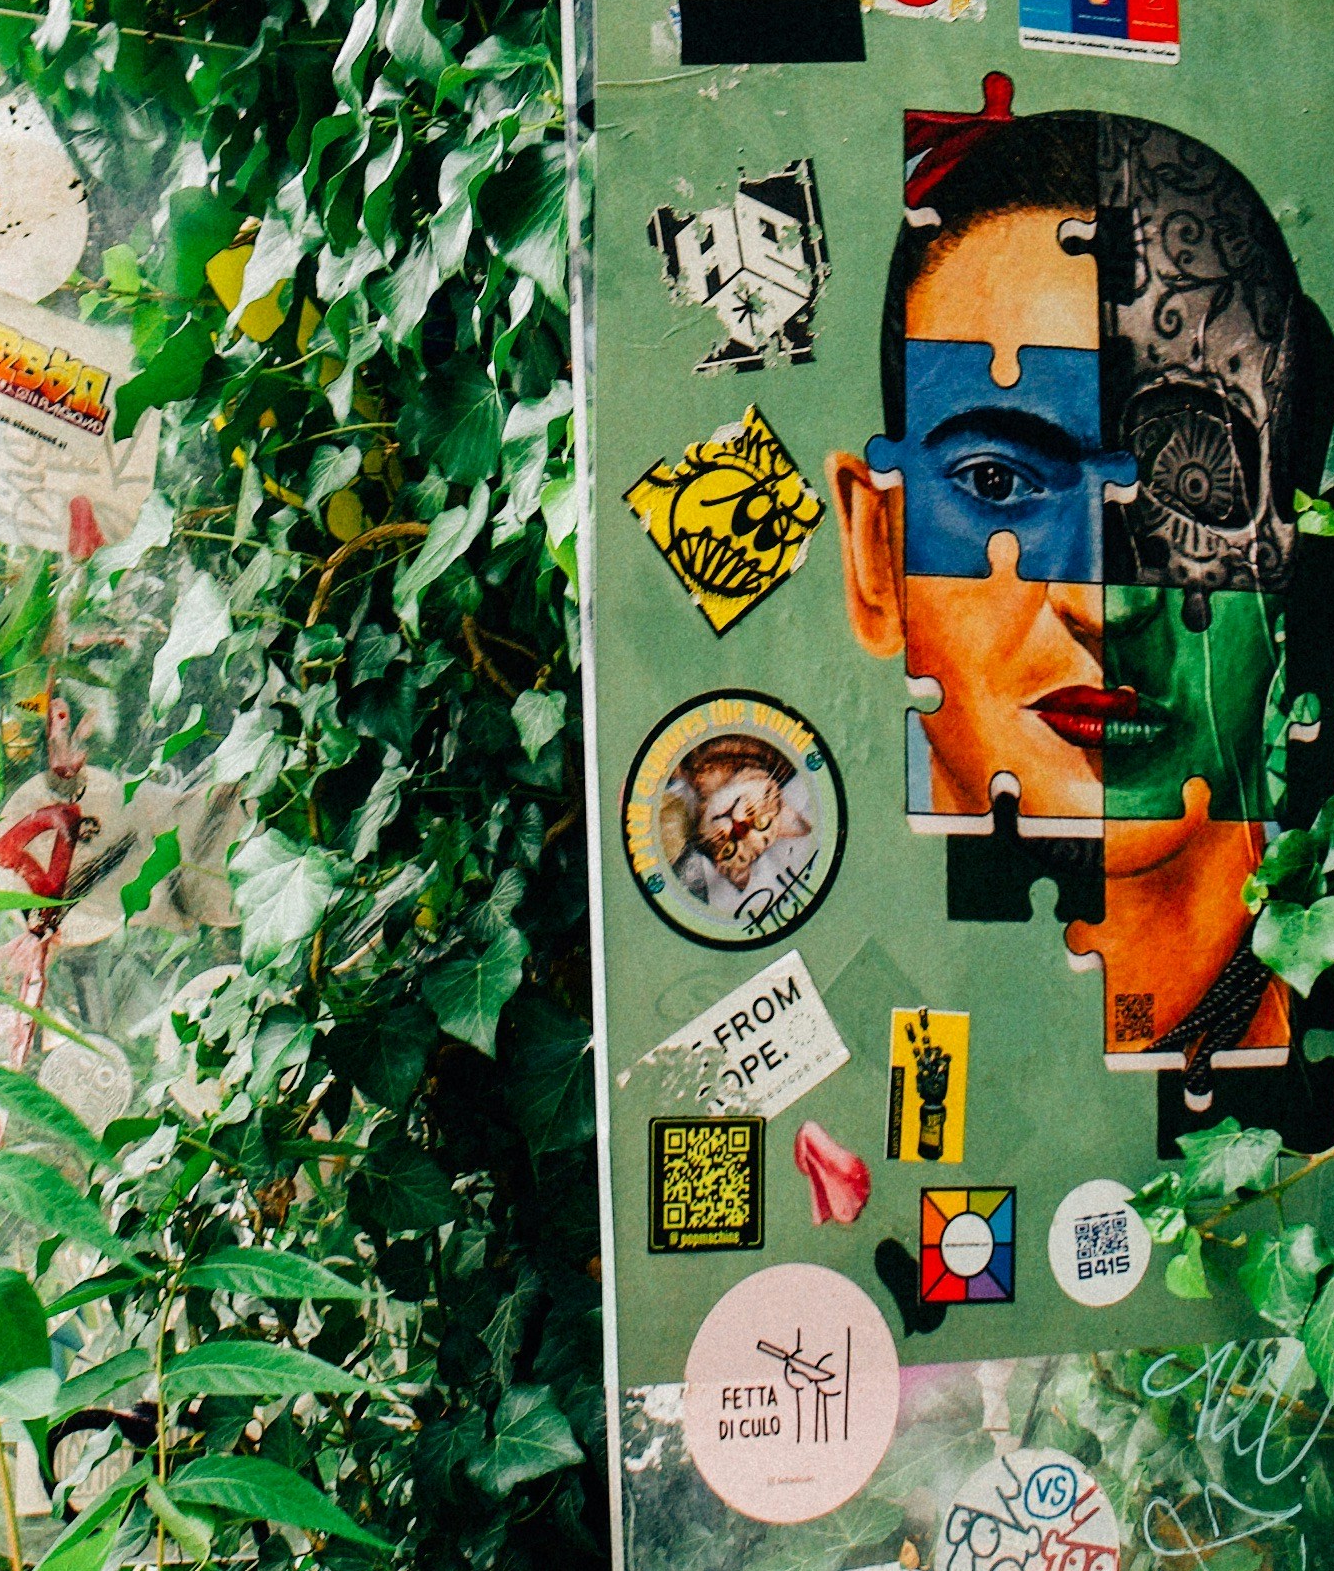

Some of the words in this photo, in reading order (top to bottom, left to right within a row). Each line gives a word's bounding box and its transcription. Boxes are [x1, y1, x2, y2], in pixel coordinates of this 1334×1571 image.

[709, 698, 745, 727] the
[713, 976, 802, 1054] FROM
[722, 1385, 778, 1410] FETTA
[719, 1419, 734, 1440] DI
[739, 1415, 780, 1438] CULO
[1035, 1475, 1067, 1506] VS
